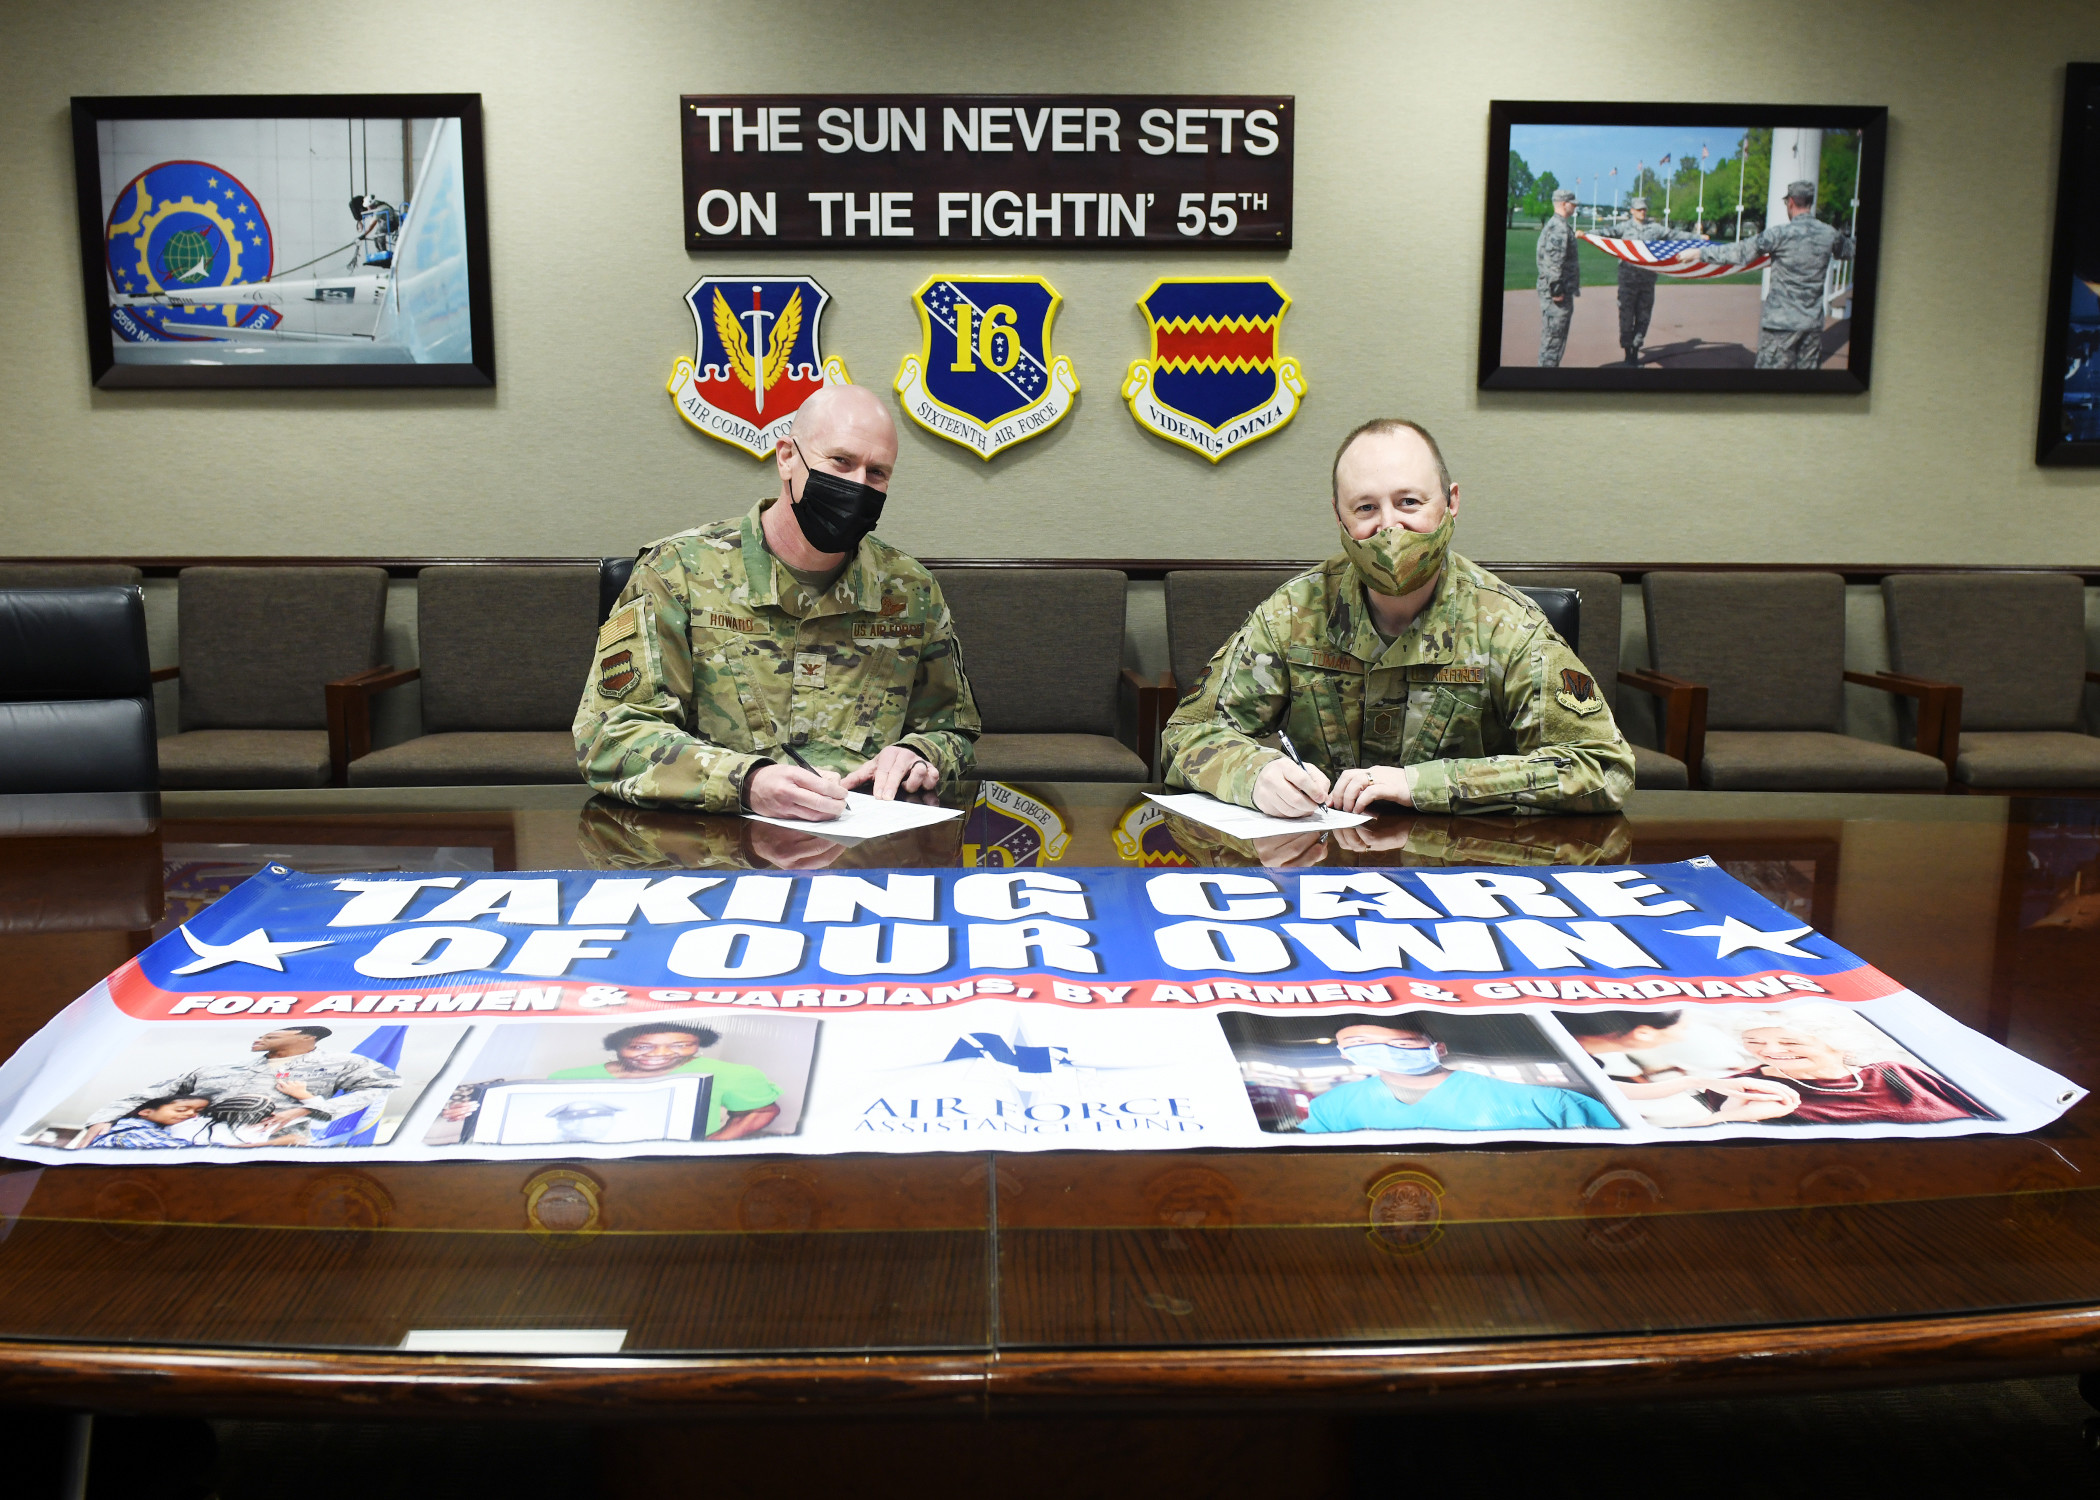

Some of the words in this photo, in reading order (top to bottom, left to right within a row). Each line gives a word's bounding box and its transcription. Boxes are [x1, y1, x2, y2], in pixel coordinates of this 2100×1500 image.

[696, 106, 803, 152] THE
[817, 107, 927, 154] SUN
[943, 107, 1121, 152] NEVER
[1138, 108, 1280, 156] SETS
[697, 188, 777, 236] ON
[808, 191, 914, 237] THE
[938, 189, 1155, 238] FIGHTIN'
[1176, 191, 1269, 237] 55TH
[113, 308, 138, 337] 55th
[949, 303, 1022, 374] 16
[683, 397, 711, 423] AIR
[711, 414, 770, 451] COMBAT
[917, 401, 988, 451] SIXTEENTH
[994, 425, 1016, 447] AIR
[1017, 401, 1059, 434] FORCE
[1149, 404, 1223, 454] VIDEMUS
[1226, 405, 1284, 444] OMNIA
[710, 613, 754, 632] HOWARD
[870, 623, 886, 637] AIR
[1312, 651, 1351, 670] TUMAN
[1432, 668, 1448, 682] AIR
[1450, 667, 1482, 683] FORCE
[327, 872, 1092, 927] TAKING
[1145, 869, 1697, 921] CARE
[353, 926, 626, 979] OF
[667, 918, 1099, 979] OUR
[1154, 918, 1662, 974] OWN
[168, 995, 298, 1016] FOR
[304, 986, 563, 1014] AIRMEN
[577, 985, 629, 1009] &
[648, 977, 1034, 1010] GUARDIANS,
[1052, 980, 1132, 1005] BY
[1150, 981, 1393, 1004] AIRMEN
[1409, 981, 1462, 1003] &
[1473, 974, 1827, 1001] GUARDIANS
[854, 1118, 1080, 1135] ASSISTANCE
[1095, 1117, 1205, 1134] FUND
[863, 1097, 972, 1119] AIR
[995, 1096, 1196, 1122] FORCE
